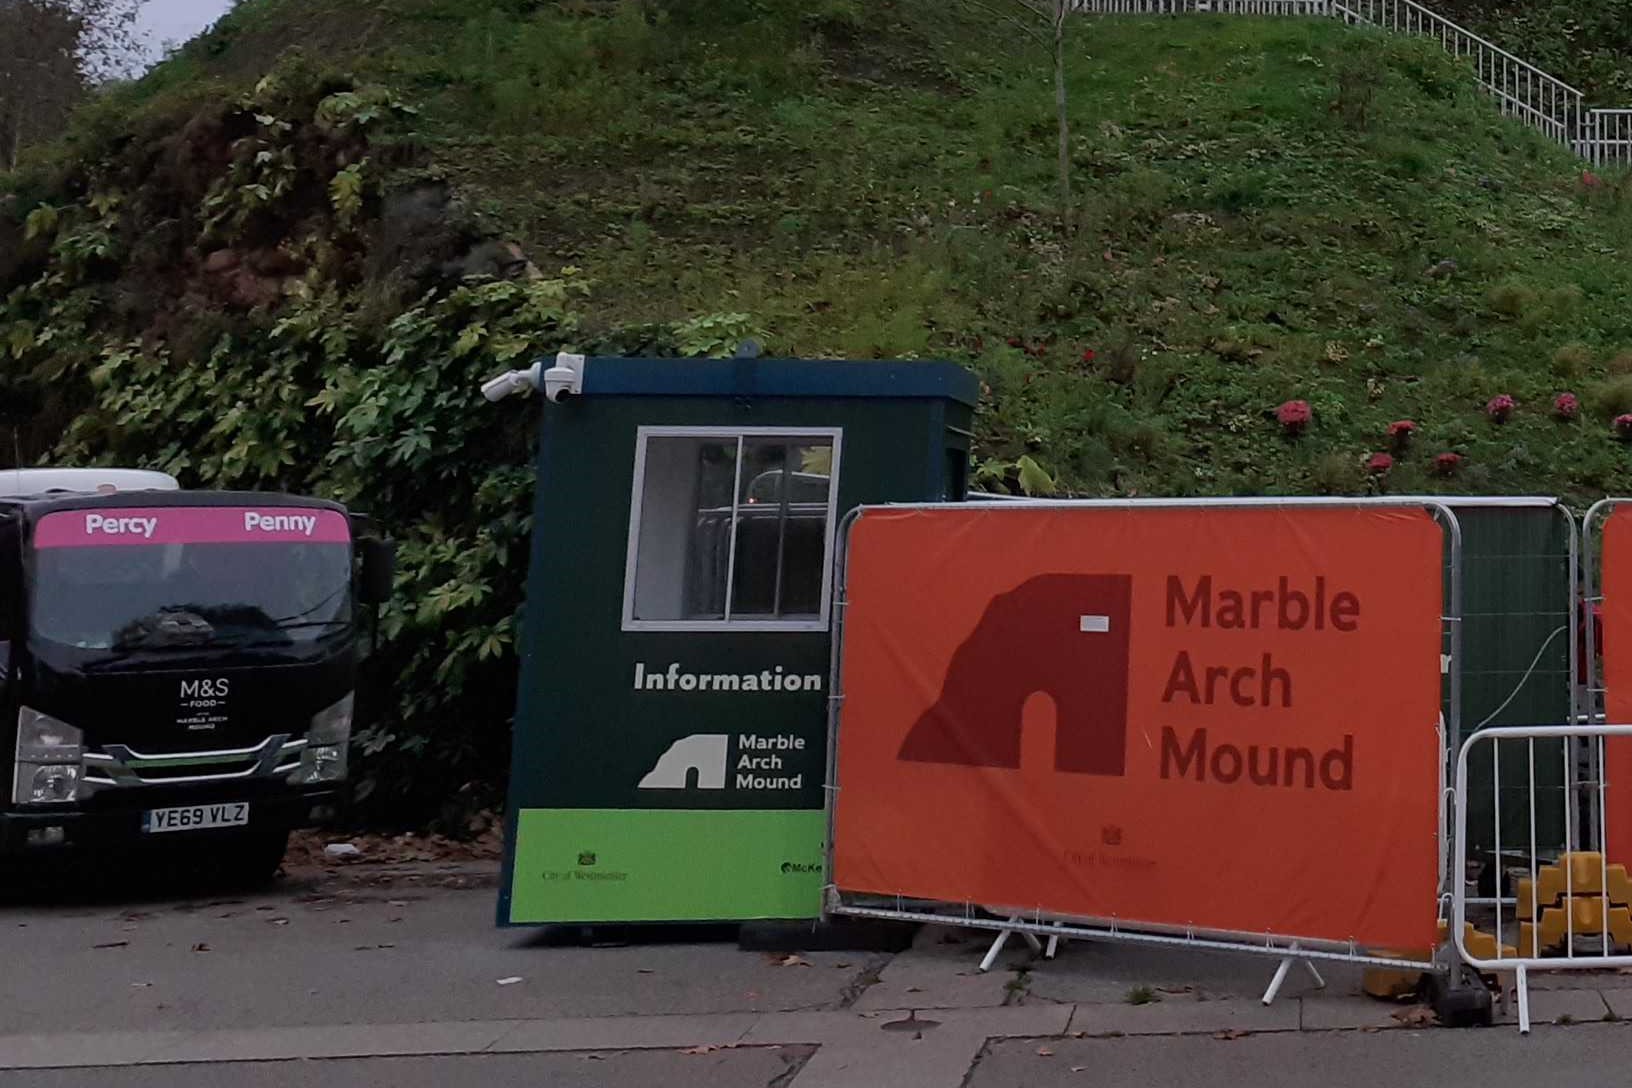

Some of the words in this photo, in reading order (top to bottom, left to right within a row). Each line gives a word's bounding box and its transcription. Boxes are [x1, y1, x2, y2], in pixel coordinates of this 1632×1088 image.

[86, 514, 157, 538] Percy
[244, 512, 316, 536] Penny
[1164, 574, 1361, 632] Marble
[180, 678, 229, 698] M&S
[634, 663, 822, 691] Information
[1161, 650, 1293, 708] Arch
[738, 734, 806, 750] Marble
[737, 754, 783, 770] Arch
[1160, 726, 1354, 791] Mound
[736, 773, 802, 790] Mound
[155, 808, 204, 828] YE69
[210, 804, 246, 823] VLZ
